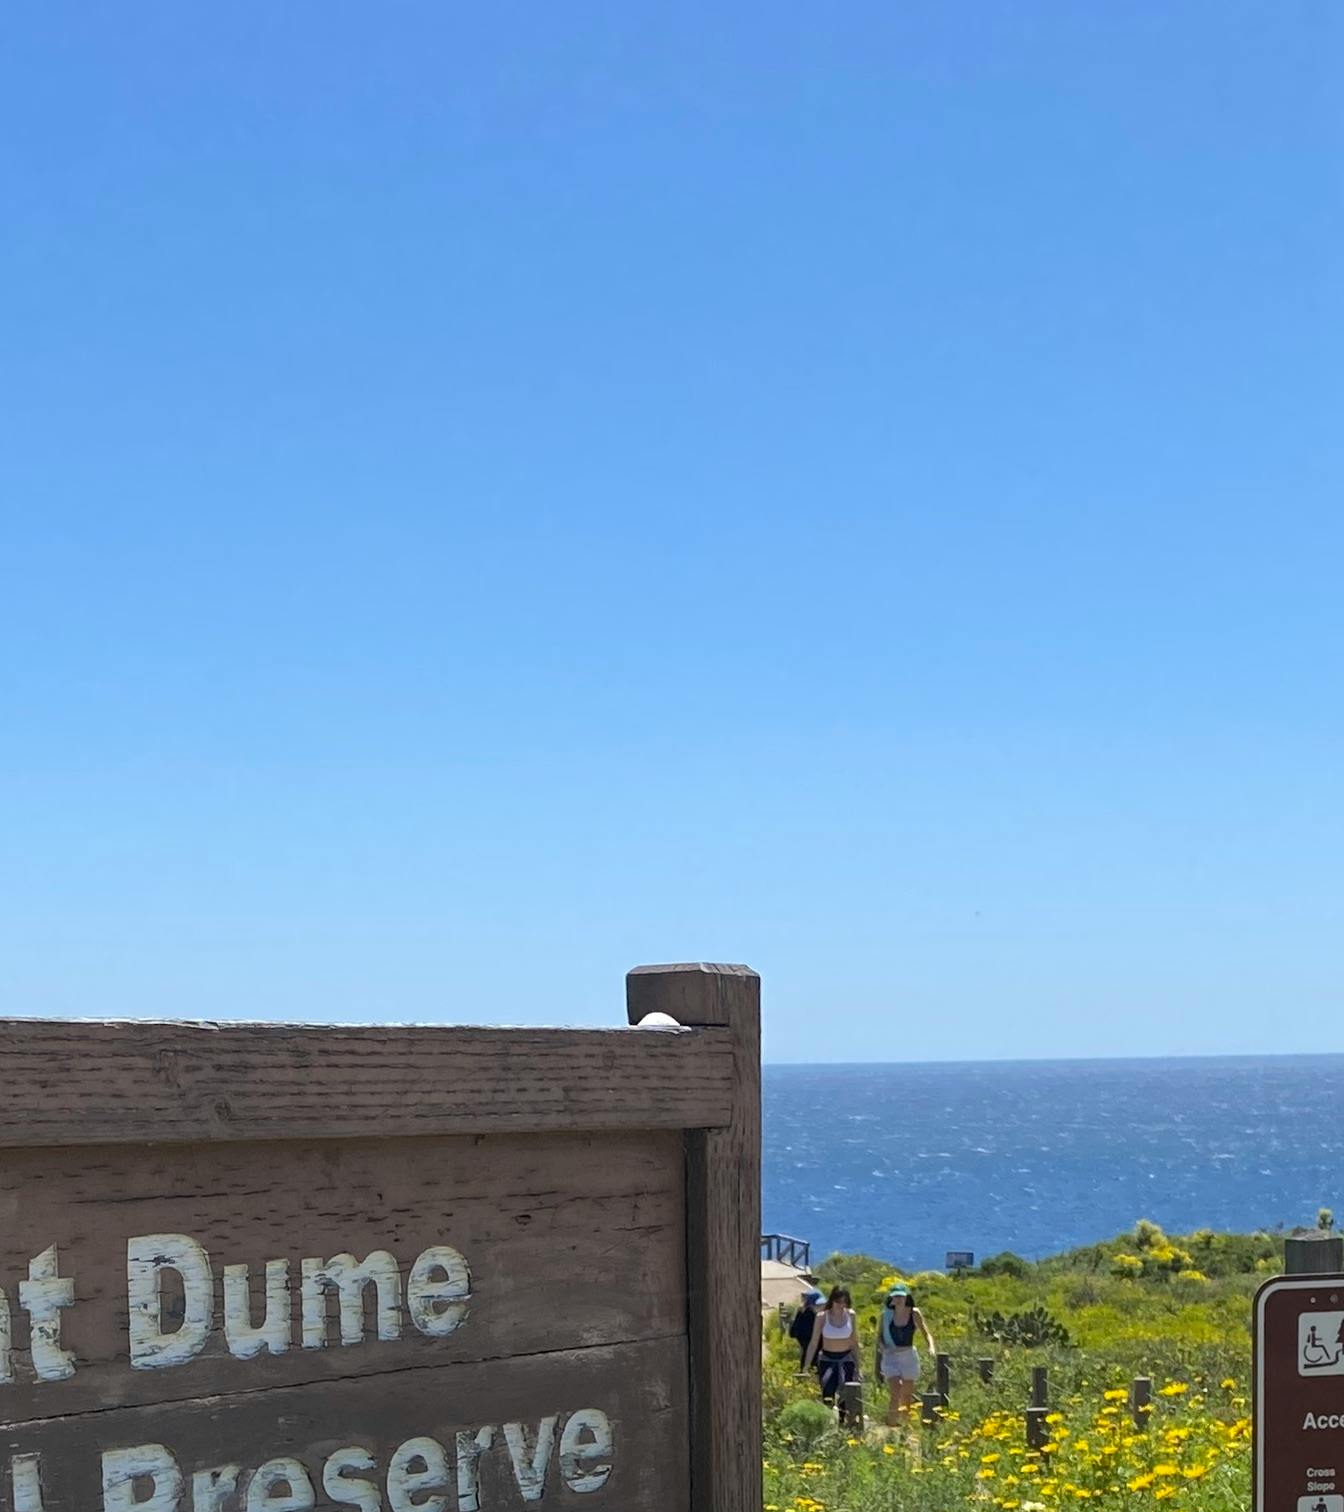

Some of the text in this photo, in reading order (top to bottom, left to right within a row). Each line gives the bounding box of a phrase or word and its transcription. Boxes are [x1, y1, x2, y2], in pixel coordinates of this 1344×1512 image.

[126, 1232, 472, 1370] Dume
[1306, 1467, 1336, 1478] Cross
[1307, 1482, 1335, 1492] Slope
